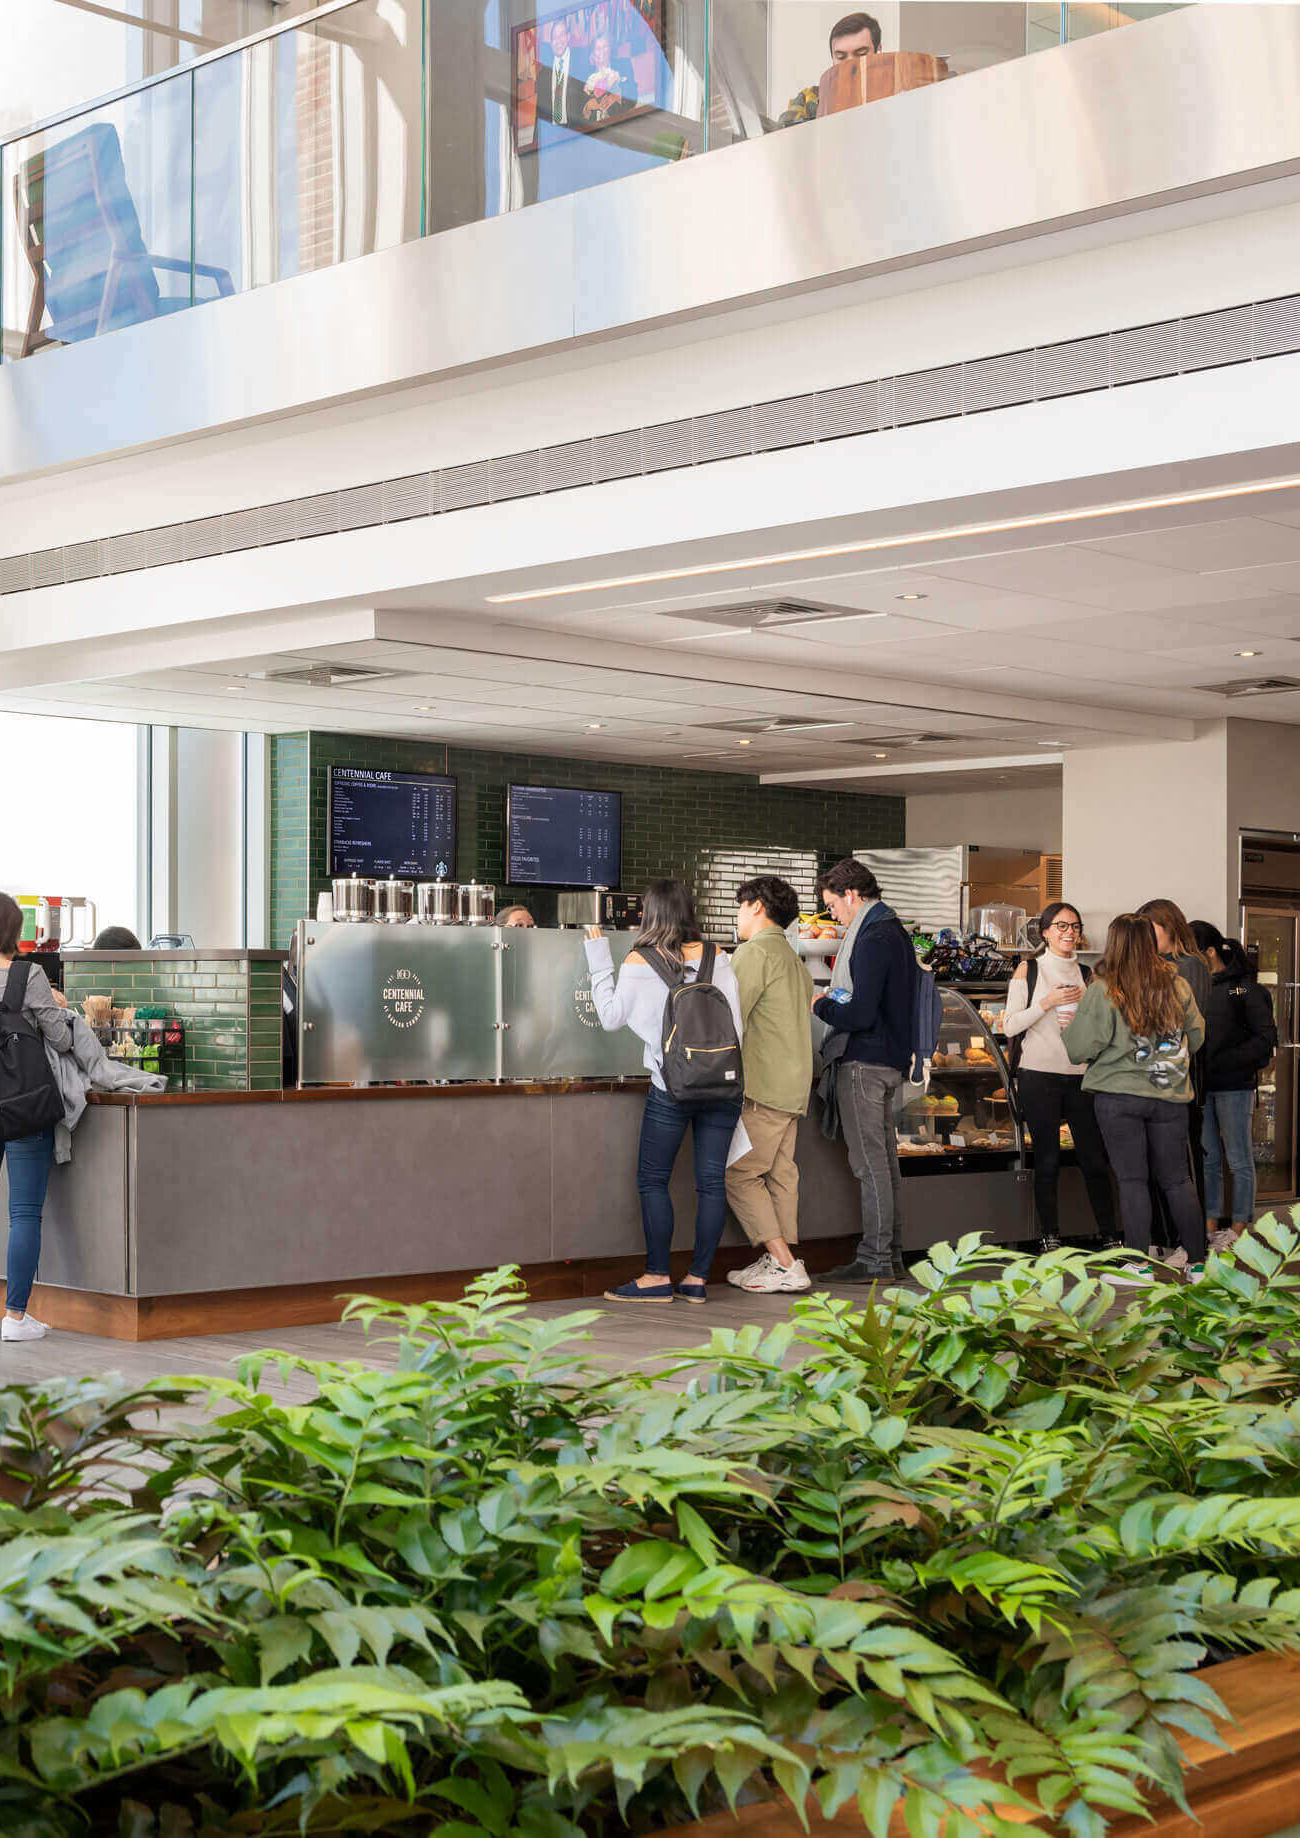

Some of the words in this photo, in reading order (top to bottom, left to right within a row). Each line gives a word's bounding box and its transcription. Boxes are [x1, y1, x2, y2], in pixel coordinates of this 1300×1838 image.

[333, 768, 374, 780] CENTENNIAL
[375, 771, 392, 781] CAFE
[383, 988, 425, 1000] CENTENNIAL
[395, 1001, 413, 1012] CAFE
